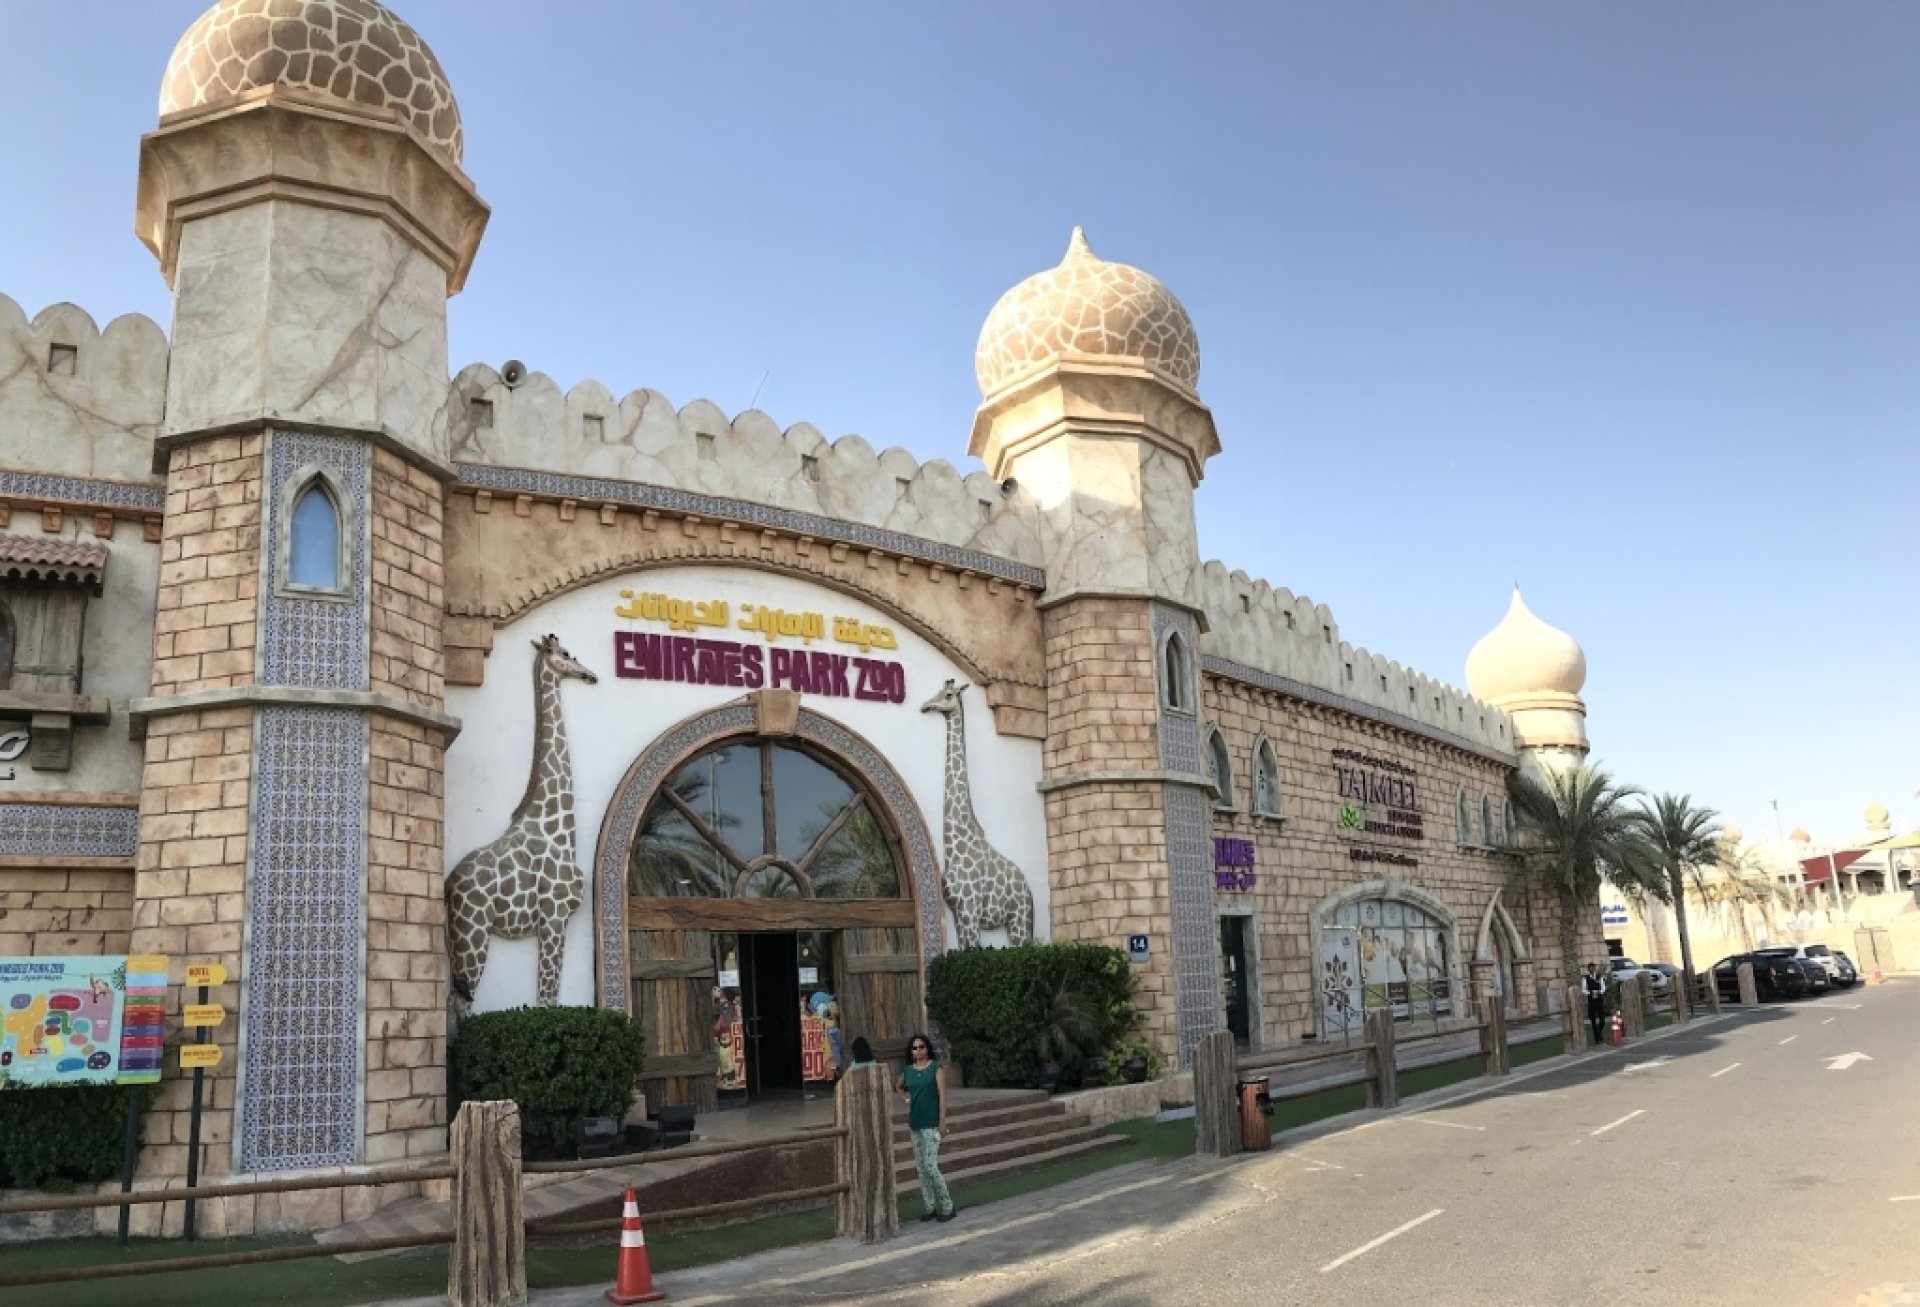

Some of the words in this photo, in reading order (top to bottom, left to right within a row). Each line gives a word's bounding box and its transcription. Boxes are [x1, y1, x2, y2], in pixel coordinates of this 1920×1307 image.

[615, 590, 730, 631] للحيوانات
[833, 616, 898, 652] حديقة
[614, 631, 764, 688] EMIRATES
[769, 647, 849, 697] PARK
[853, 657, 906, 704] ZOO
[1132, 938, 1146, 950] 14
